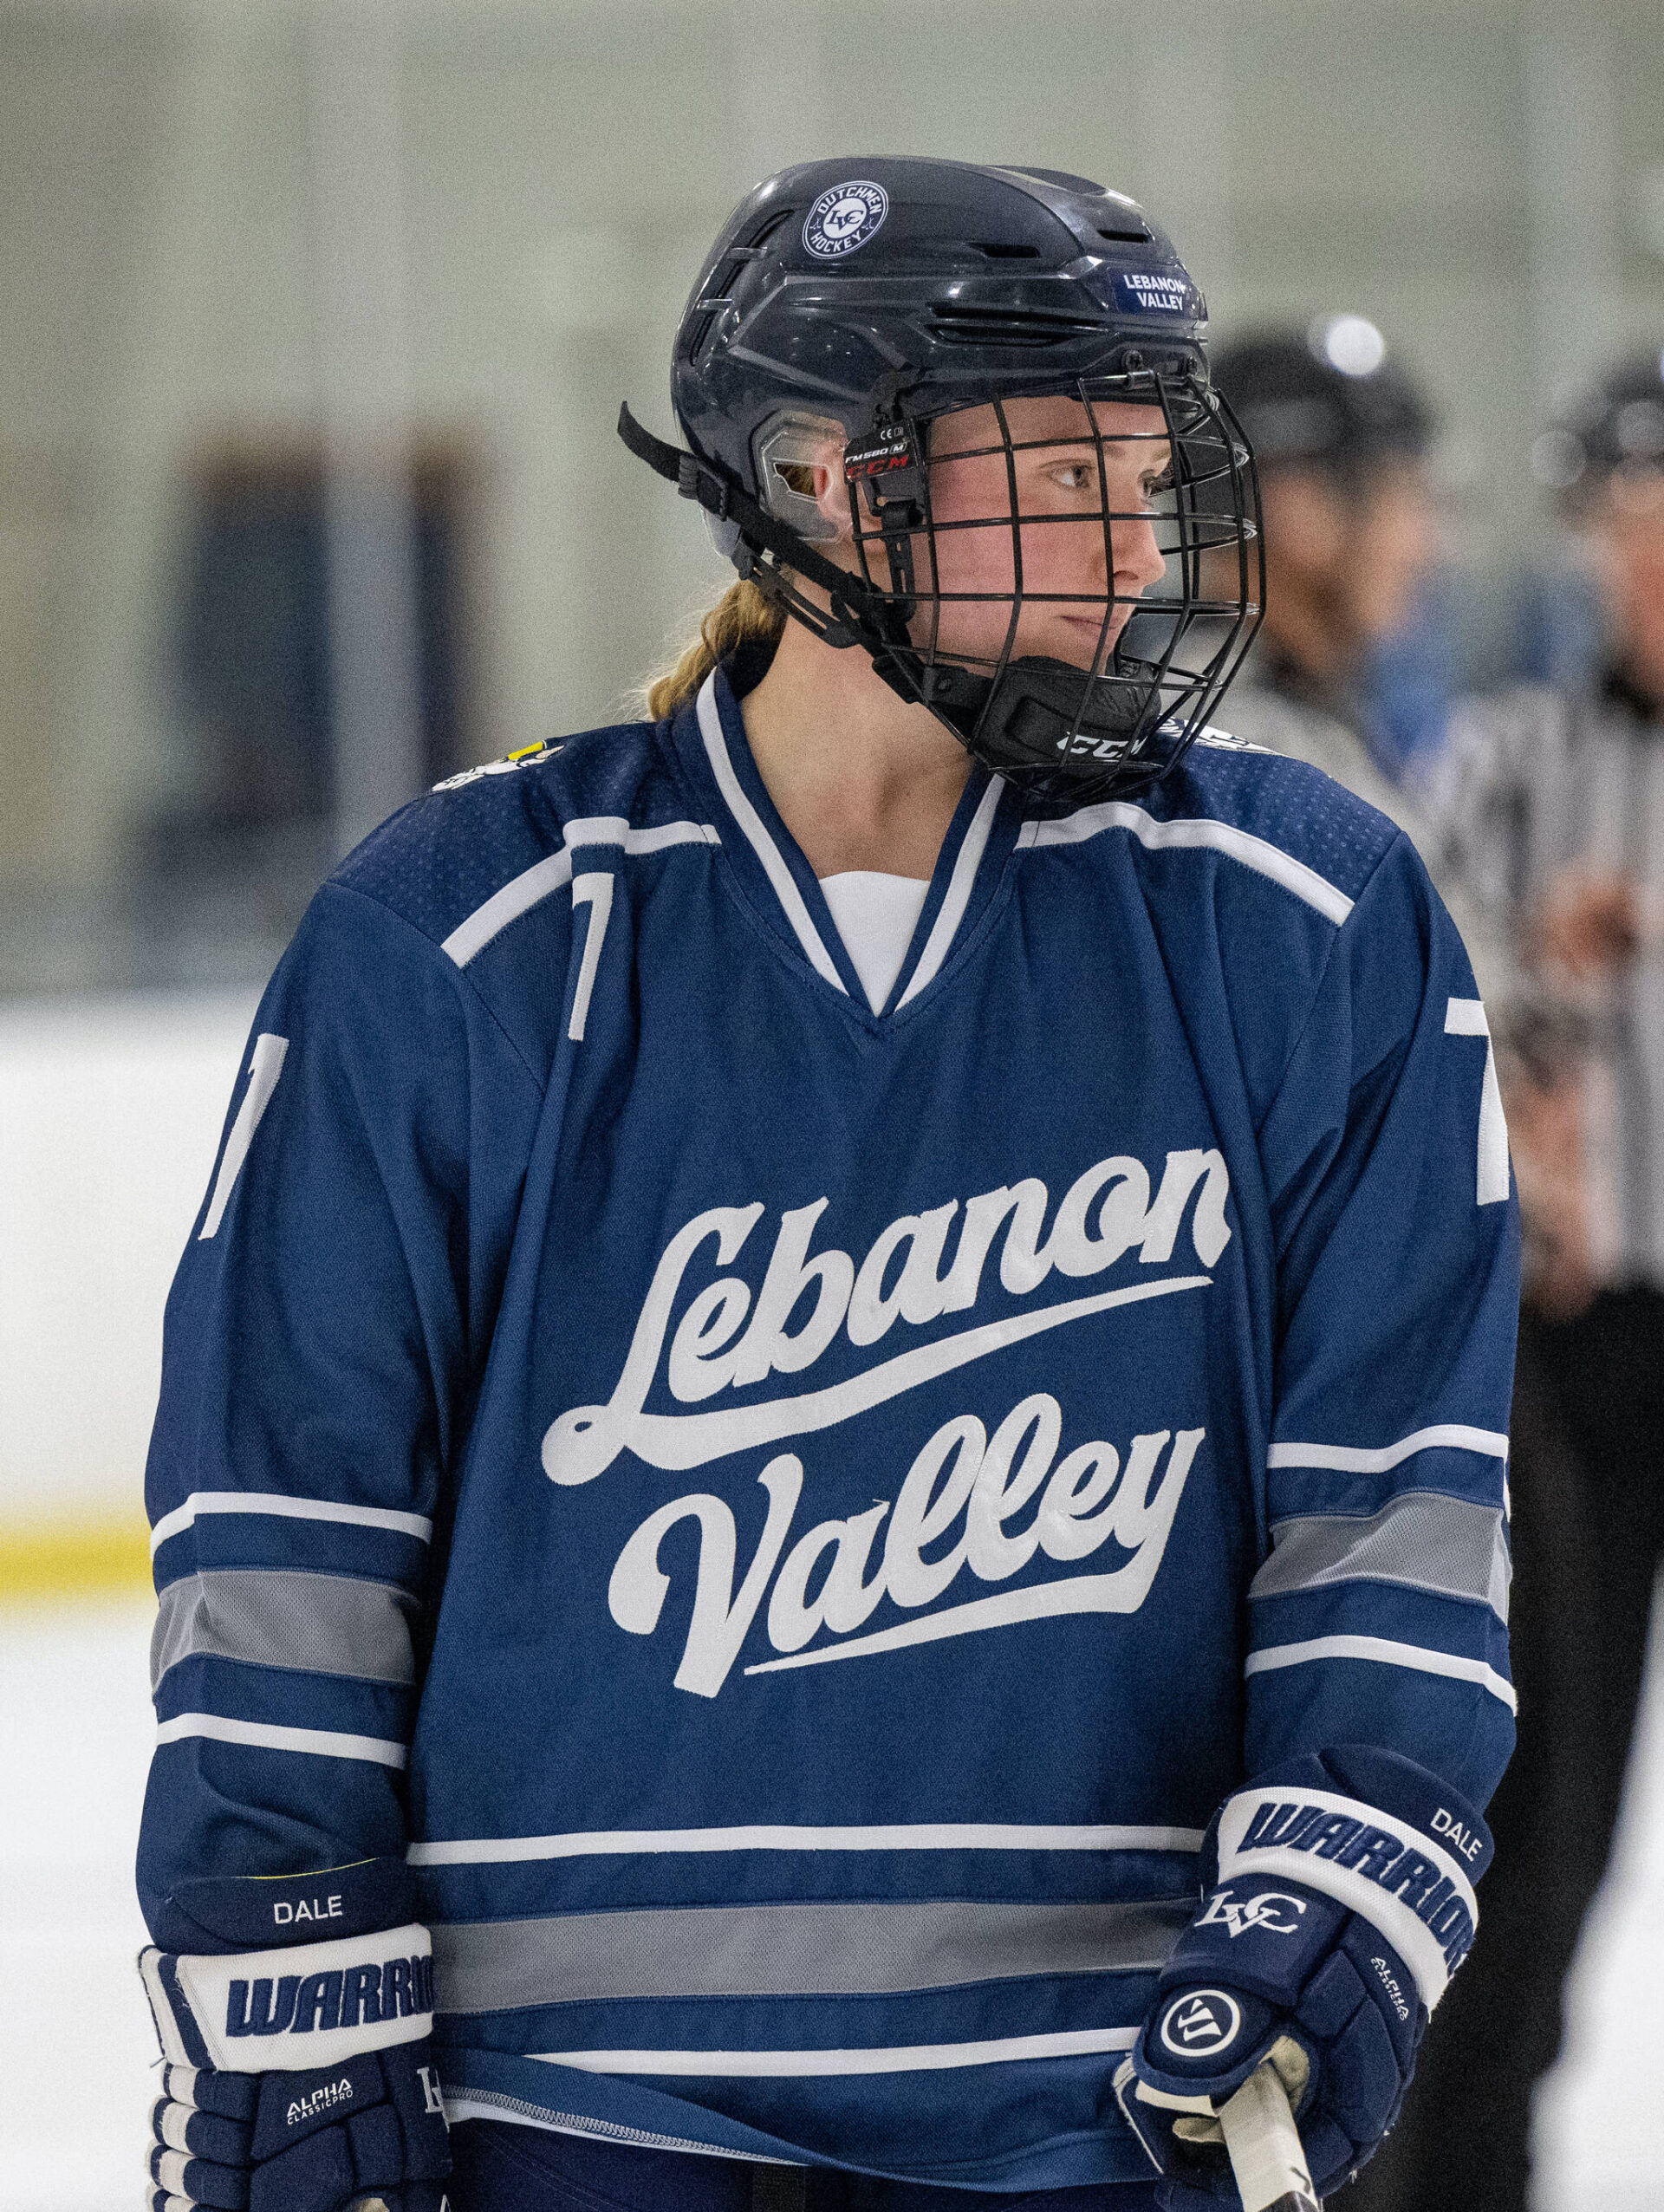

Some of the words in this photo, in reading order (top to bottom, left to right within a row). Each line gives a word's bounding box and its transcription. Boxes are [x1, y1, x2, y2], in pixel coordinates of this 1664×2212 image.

[816, 185, 882, 215] DUTCHMEN
[825, 209, 864, 231] LVC
[809, 230, 861, 253] HOCKEY
[1123, 274, 1186, 295] LEBANON
[1136, 291, 1183, 311] VALLEY
[845, 447, 889, 464] FM580
[847, 454, 909, 479] CCM
[567, 871, 615, 1042] 7
[1443, 997, 1511, 1206] 7
[541, 1148, 1232, 1487] Lebanon
[608, 1393, 1206, 1699] Valley
[1429, 1806, 1485, 1864] DALE
[273, 1894, 344, 1925] DALE
[1193, 1891, 1307, 1938] LVC
[1375, 1956, 1409, 2020] ALPHA
[286, 2078, 352, 2118] ALPHA
[287, 2089, 354, 2125] CLASSICPRO
